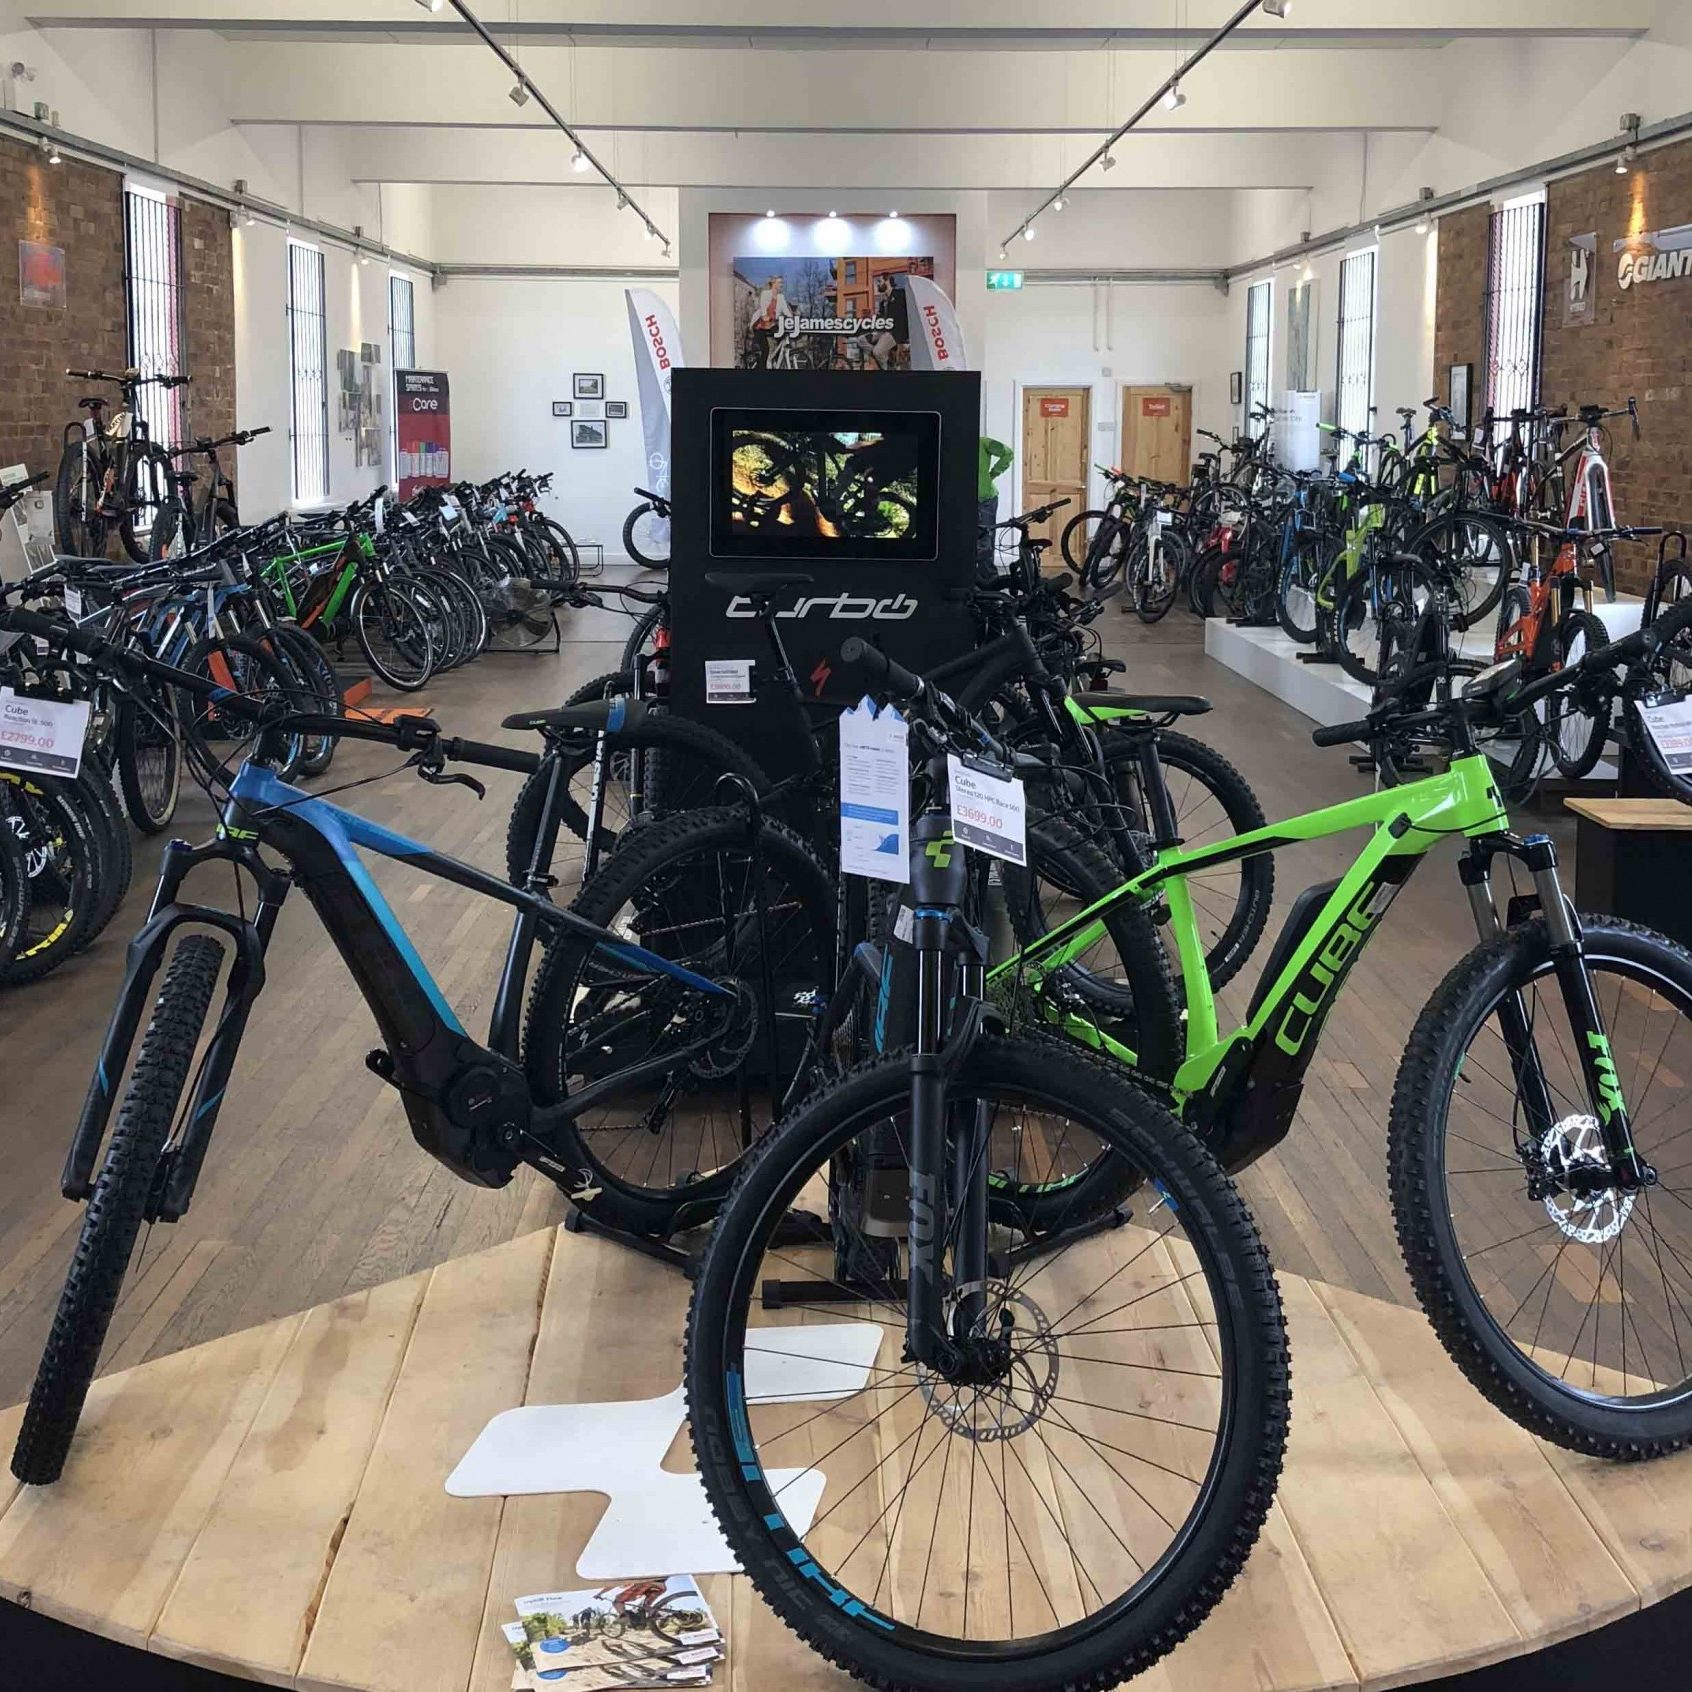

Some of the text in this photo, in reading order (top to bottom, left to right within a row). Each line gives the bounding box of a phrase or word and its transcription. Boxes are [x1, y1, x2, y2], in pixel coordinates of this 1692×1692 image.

[1633, 249, 1692, 284] GIANT
[5, 704, 29, 716] Cube
[954, 775, 977, 790] Cube
[909, 1166, 936, 1286] FOX
